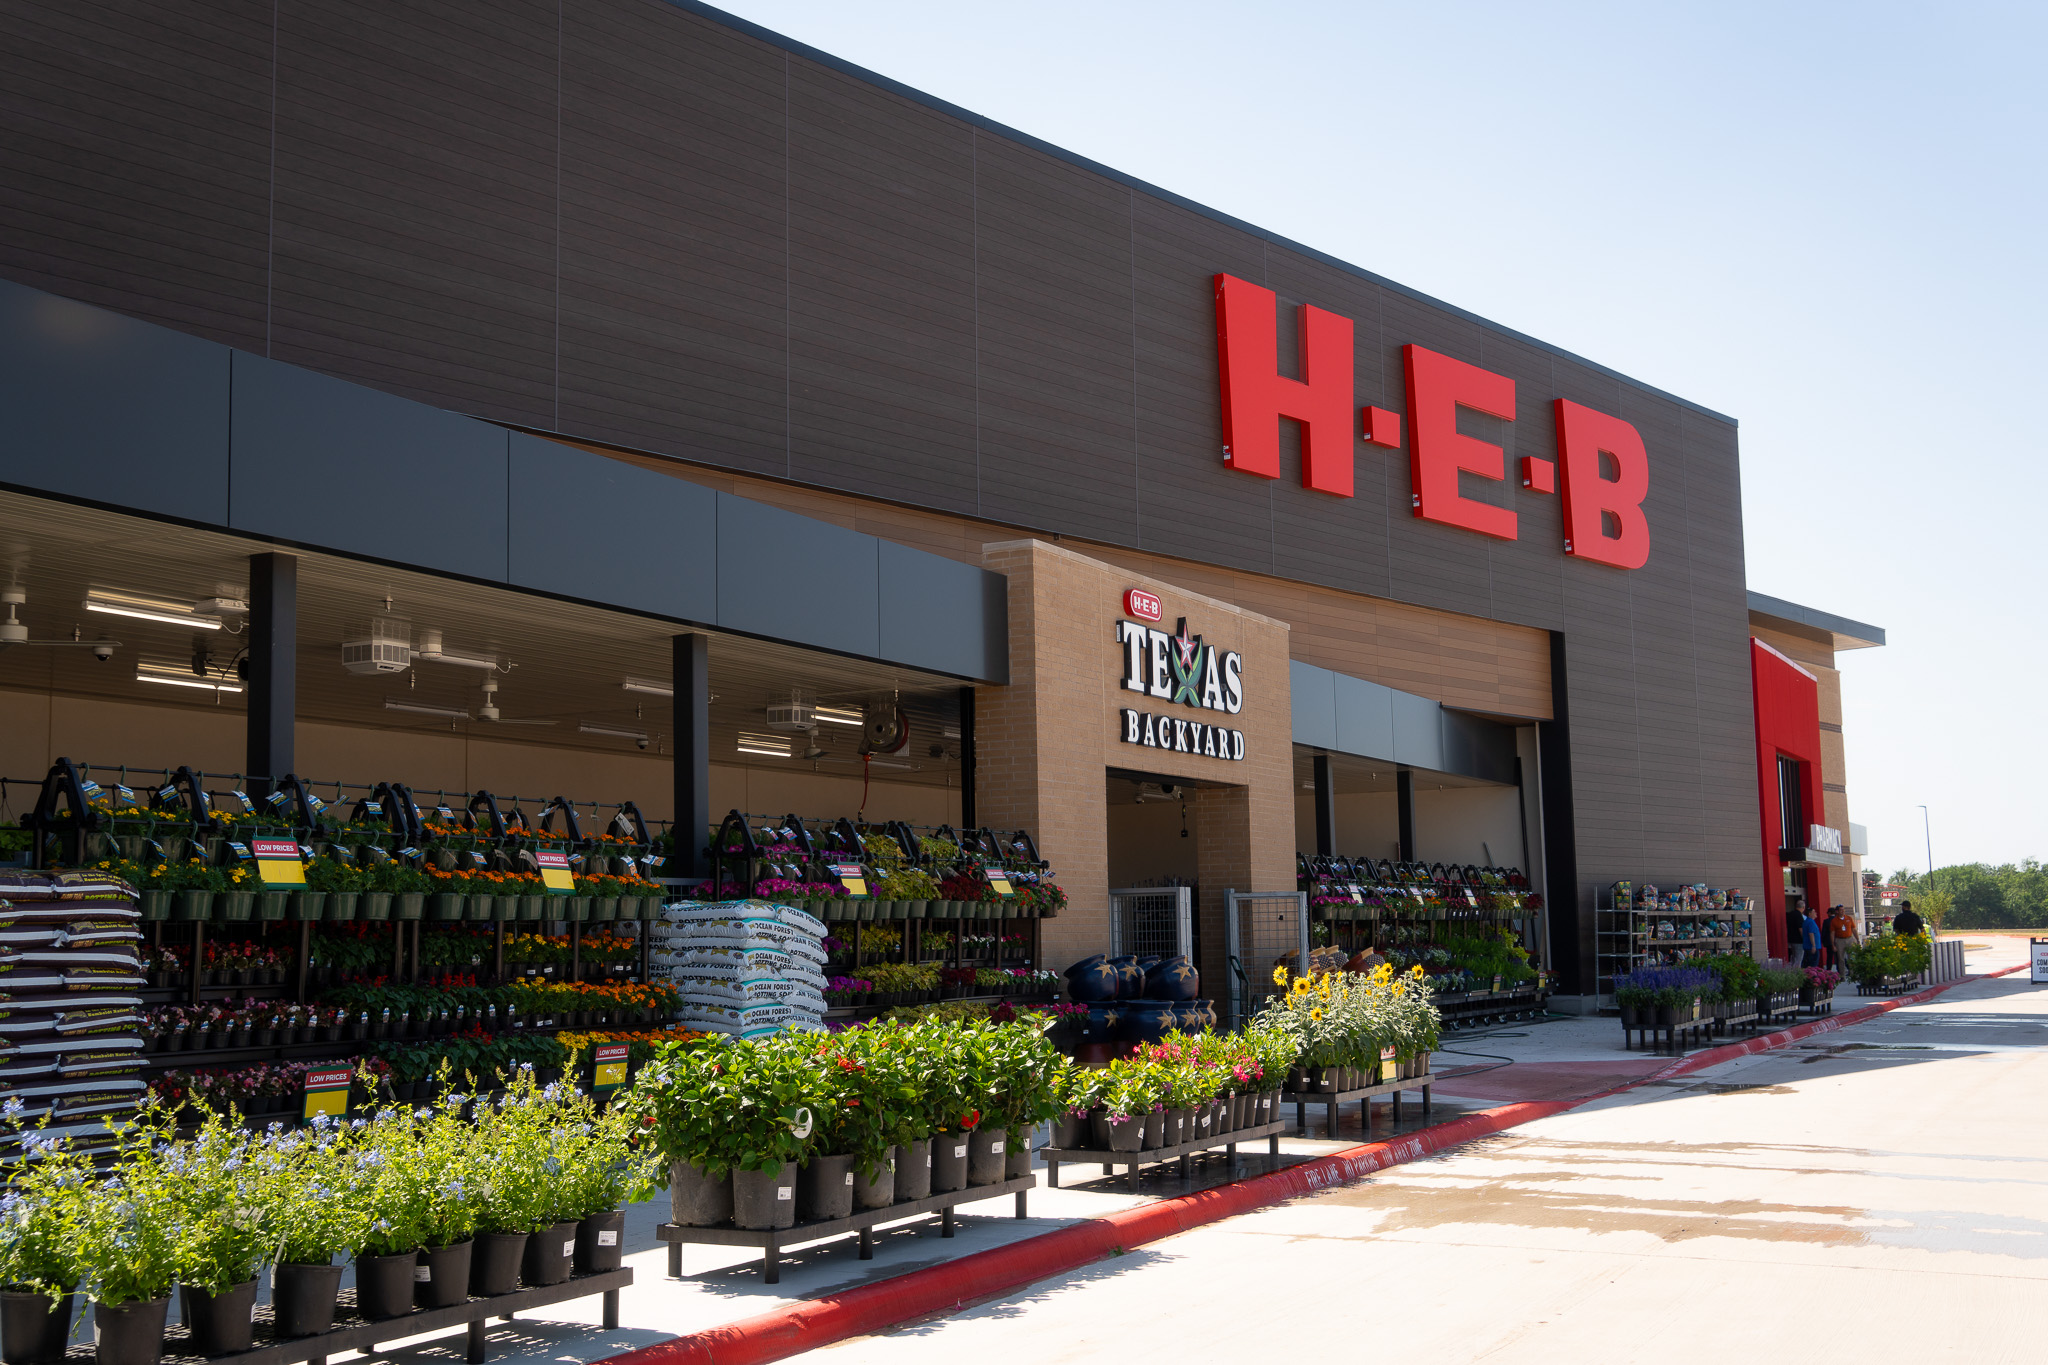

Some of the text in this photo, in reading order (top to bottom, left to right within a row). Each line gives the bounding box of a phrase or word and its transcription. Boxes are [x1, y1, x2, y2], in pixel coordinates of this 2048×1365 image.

[1214, 273, 1650, 570] H-E-B
[1120, 618, 1243, 715] TEXAS
[1123, 709, 1246, 761] BACKYARD
[1814, 824, 1842, 854] PHARMACY
[272, 844, 294, 852] PRICES
[550, 855, 565, 863] PRICES
[774, 925, 794, 935] FOREST
[754, 983, 794, 991] OCEAN FOREST
[751, 1009, 770, 1017] OCEAN
[310, 1073, 347, 1083] LOW PRICES
[1304, 1168, 1325, 1190] FIRE
[1320, 1163, 1343, 1186] LANE
[1352, 1152, 1380, 1176] PARKING
